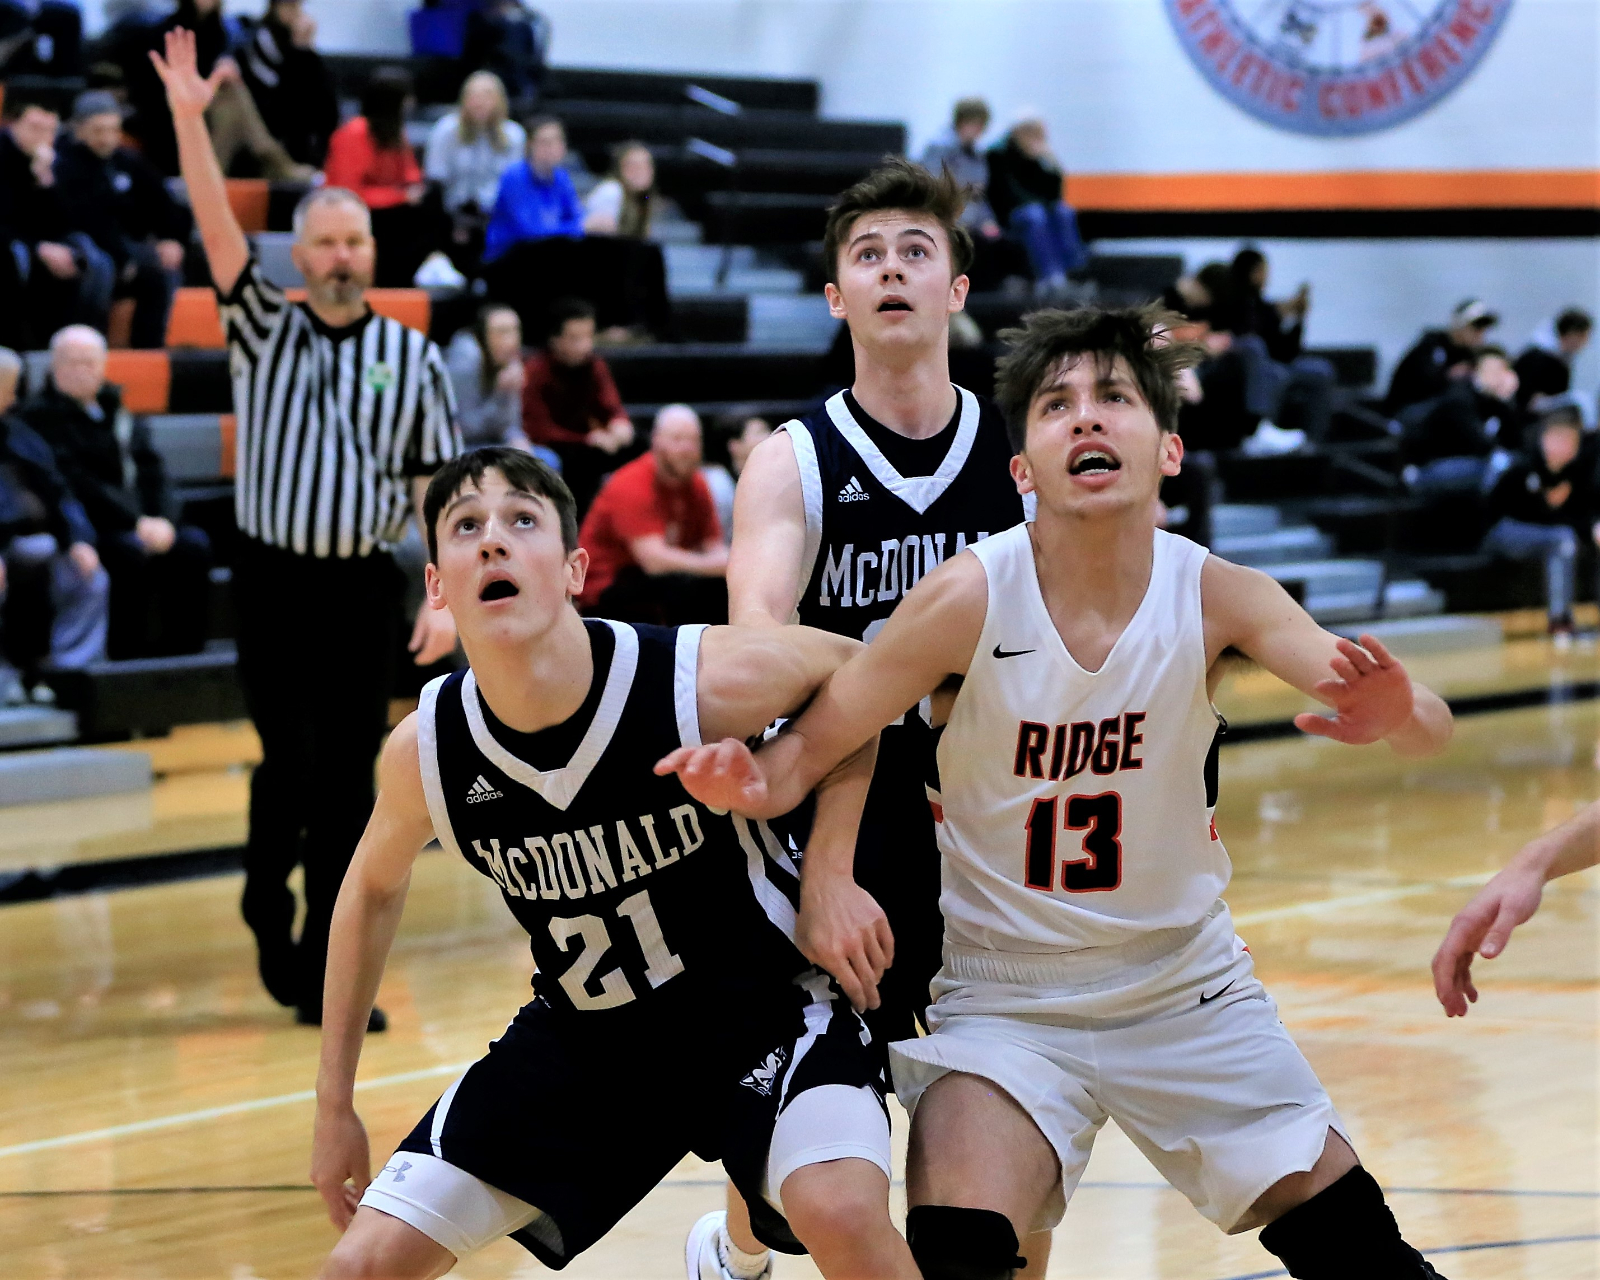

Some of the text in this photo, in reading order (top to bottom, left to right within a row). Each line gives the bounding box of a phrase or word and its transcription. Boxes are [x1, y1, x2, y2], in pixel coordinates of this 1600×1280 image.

[1318, 0, 1501, 118] CONFERENC
[838, 492, 870, 503] adidas
[1013, 711, 1147, 782] RIDGE
[466, 790, 504, 804] adidas
[1024, 790, 1123, 893] 13
[547, 889, 686, 1011] 21
